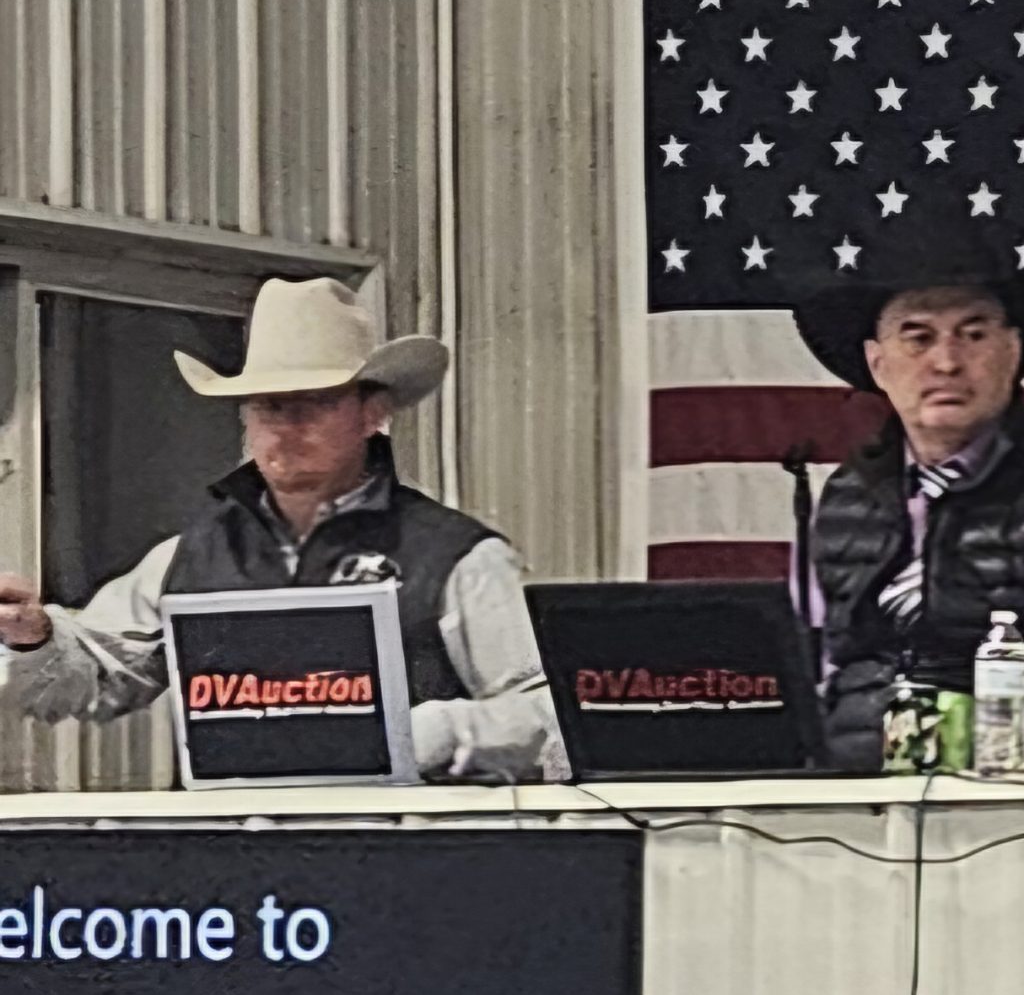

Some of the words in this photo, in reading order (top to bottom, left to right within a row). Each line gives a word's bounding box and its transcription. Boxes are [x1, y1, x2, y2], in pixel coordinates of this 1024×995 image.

[188, 671, 373, 709] DVAuction
[577, 668, 778, 700] DVAuction
[0, 884, 235, 961] elcome
[256, 894, 330, 961] to
